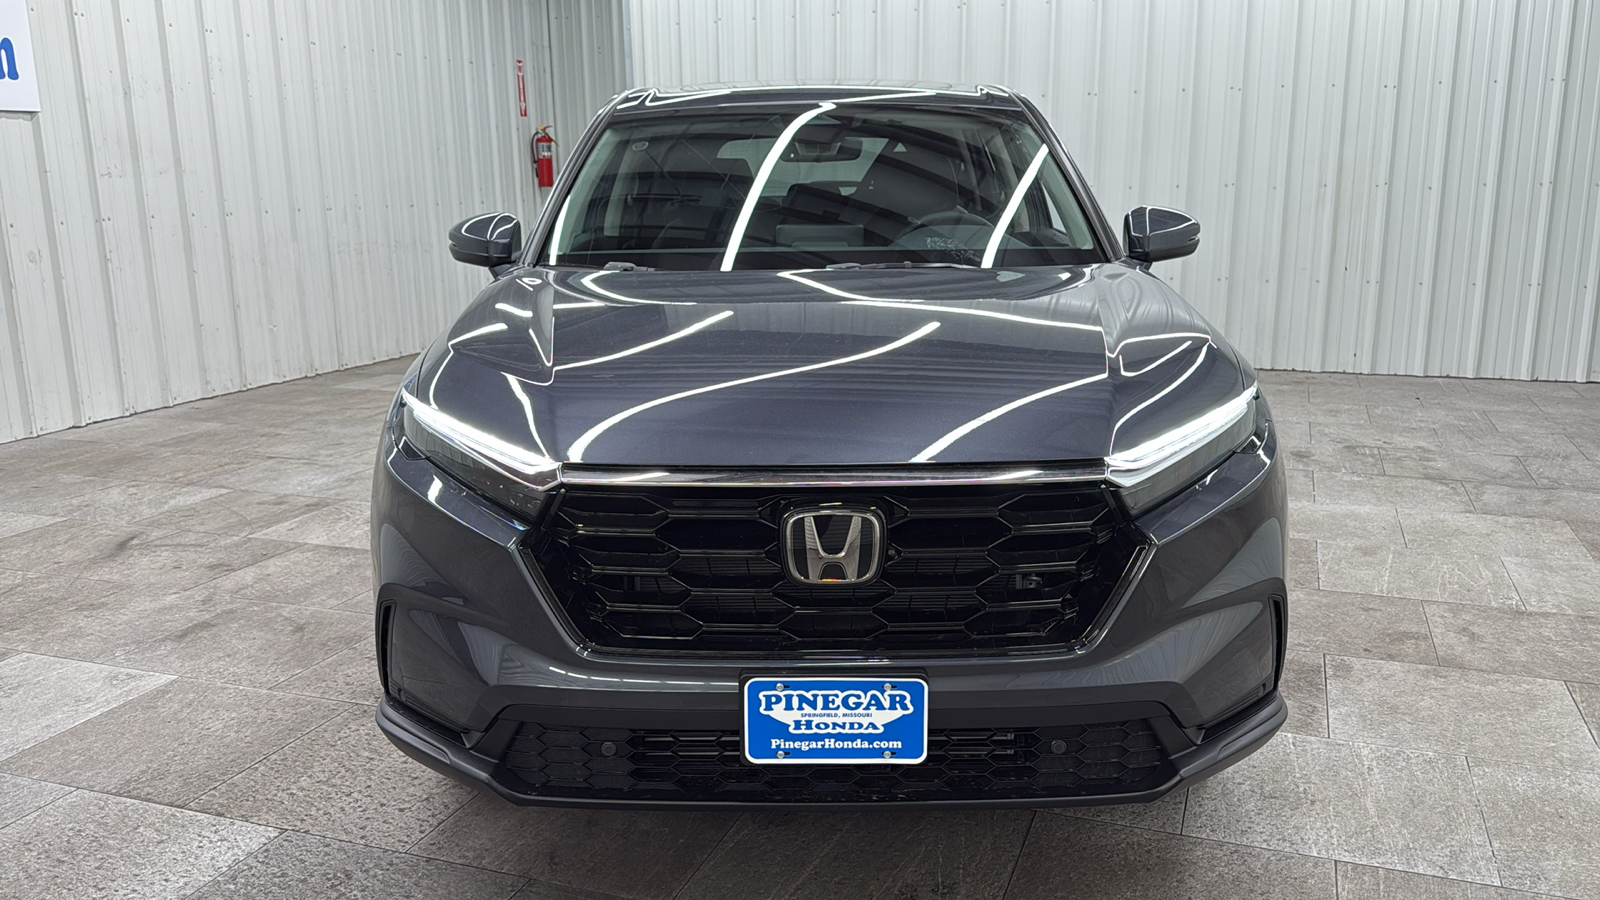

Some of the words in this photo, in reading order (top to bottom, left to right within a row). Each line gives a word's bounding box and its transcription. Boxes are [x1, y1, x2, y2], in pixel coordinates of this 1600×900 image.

[763, 693, 910, 711] PINEGAR
[793, 720, 881, 731] HONDA
[771, 739, 902, 750] PinegarHonda.com
